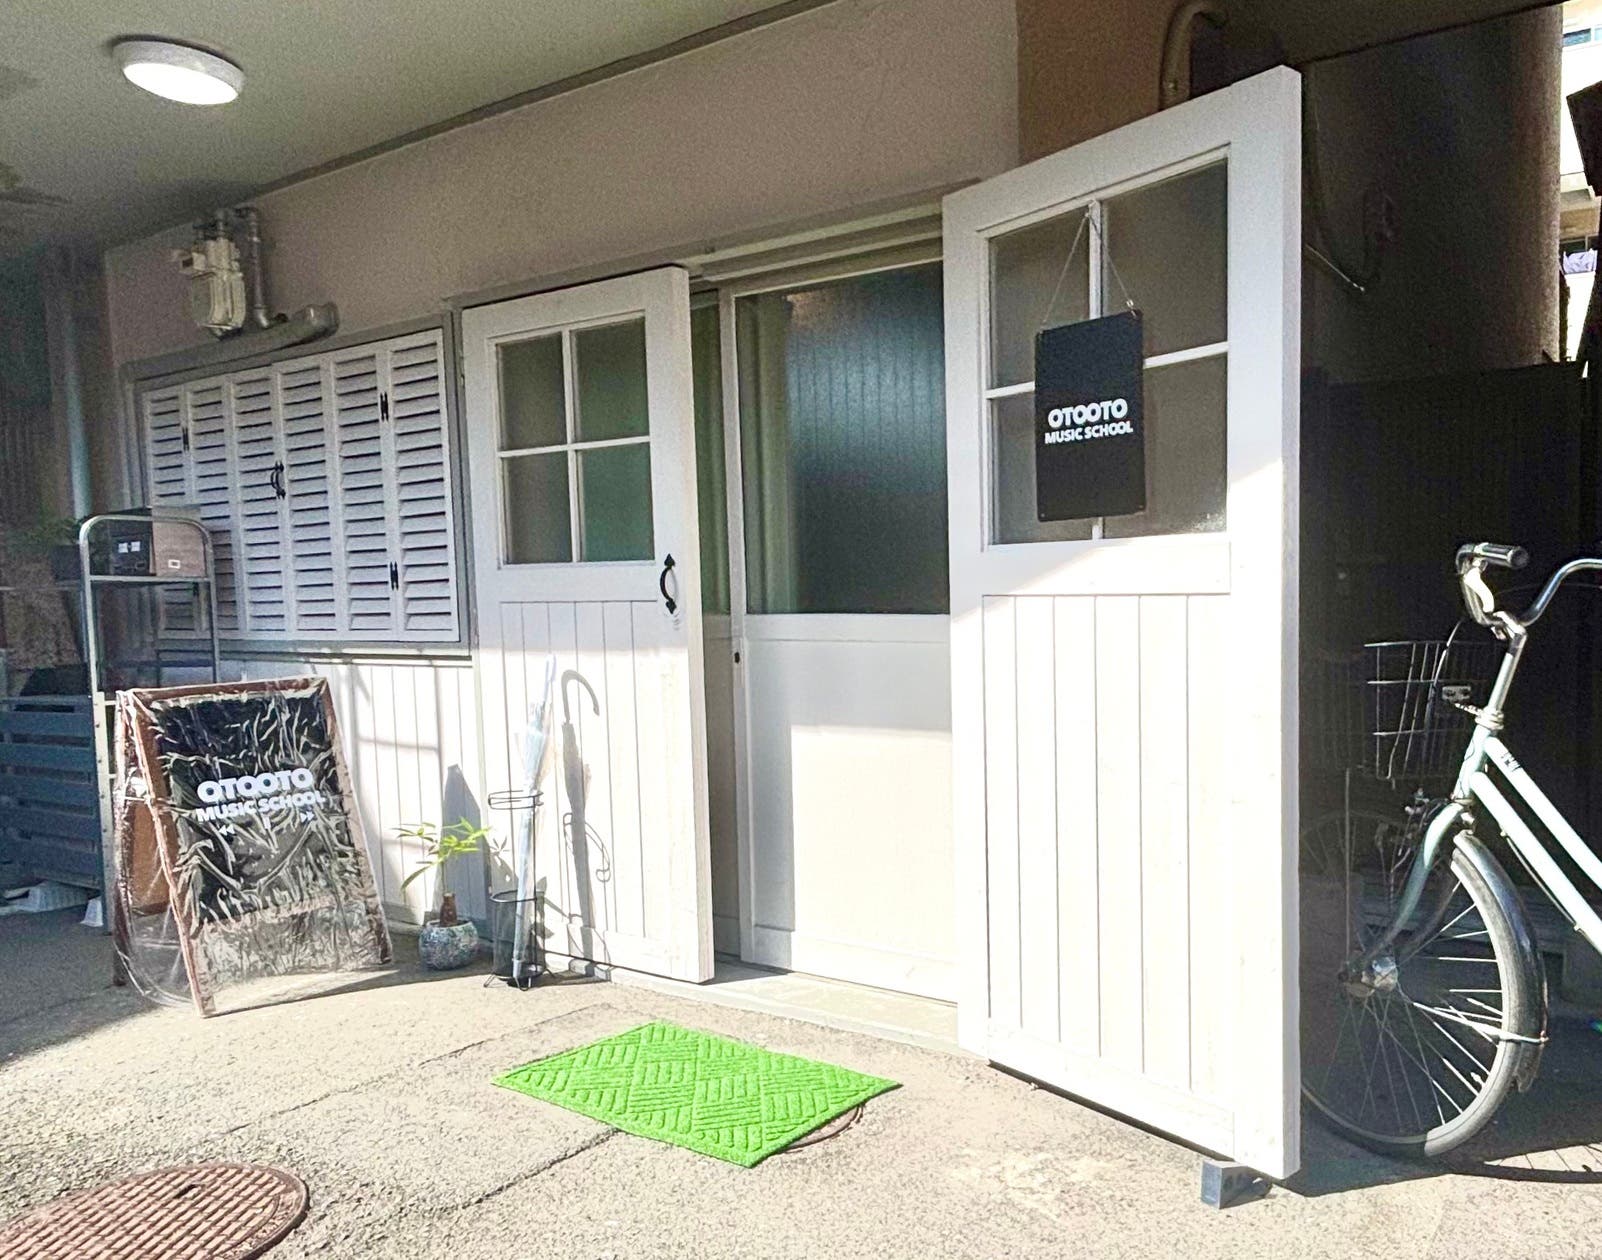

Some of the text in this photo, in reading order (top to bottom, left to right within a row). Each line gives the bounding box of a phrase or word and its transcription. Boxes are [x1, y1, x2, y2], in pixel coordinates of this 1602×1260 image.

[1048, 398, 1128, 428] OTOOTO
[1044, 421, 1134, 444] MUSIC SCHOOL
[197, 768, 313, 803] OTOOTO
[195, 790, 326, 822] MUSIC SCHOOL
